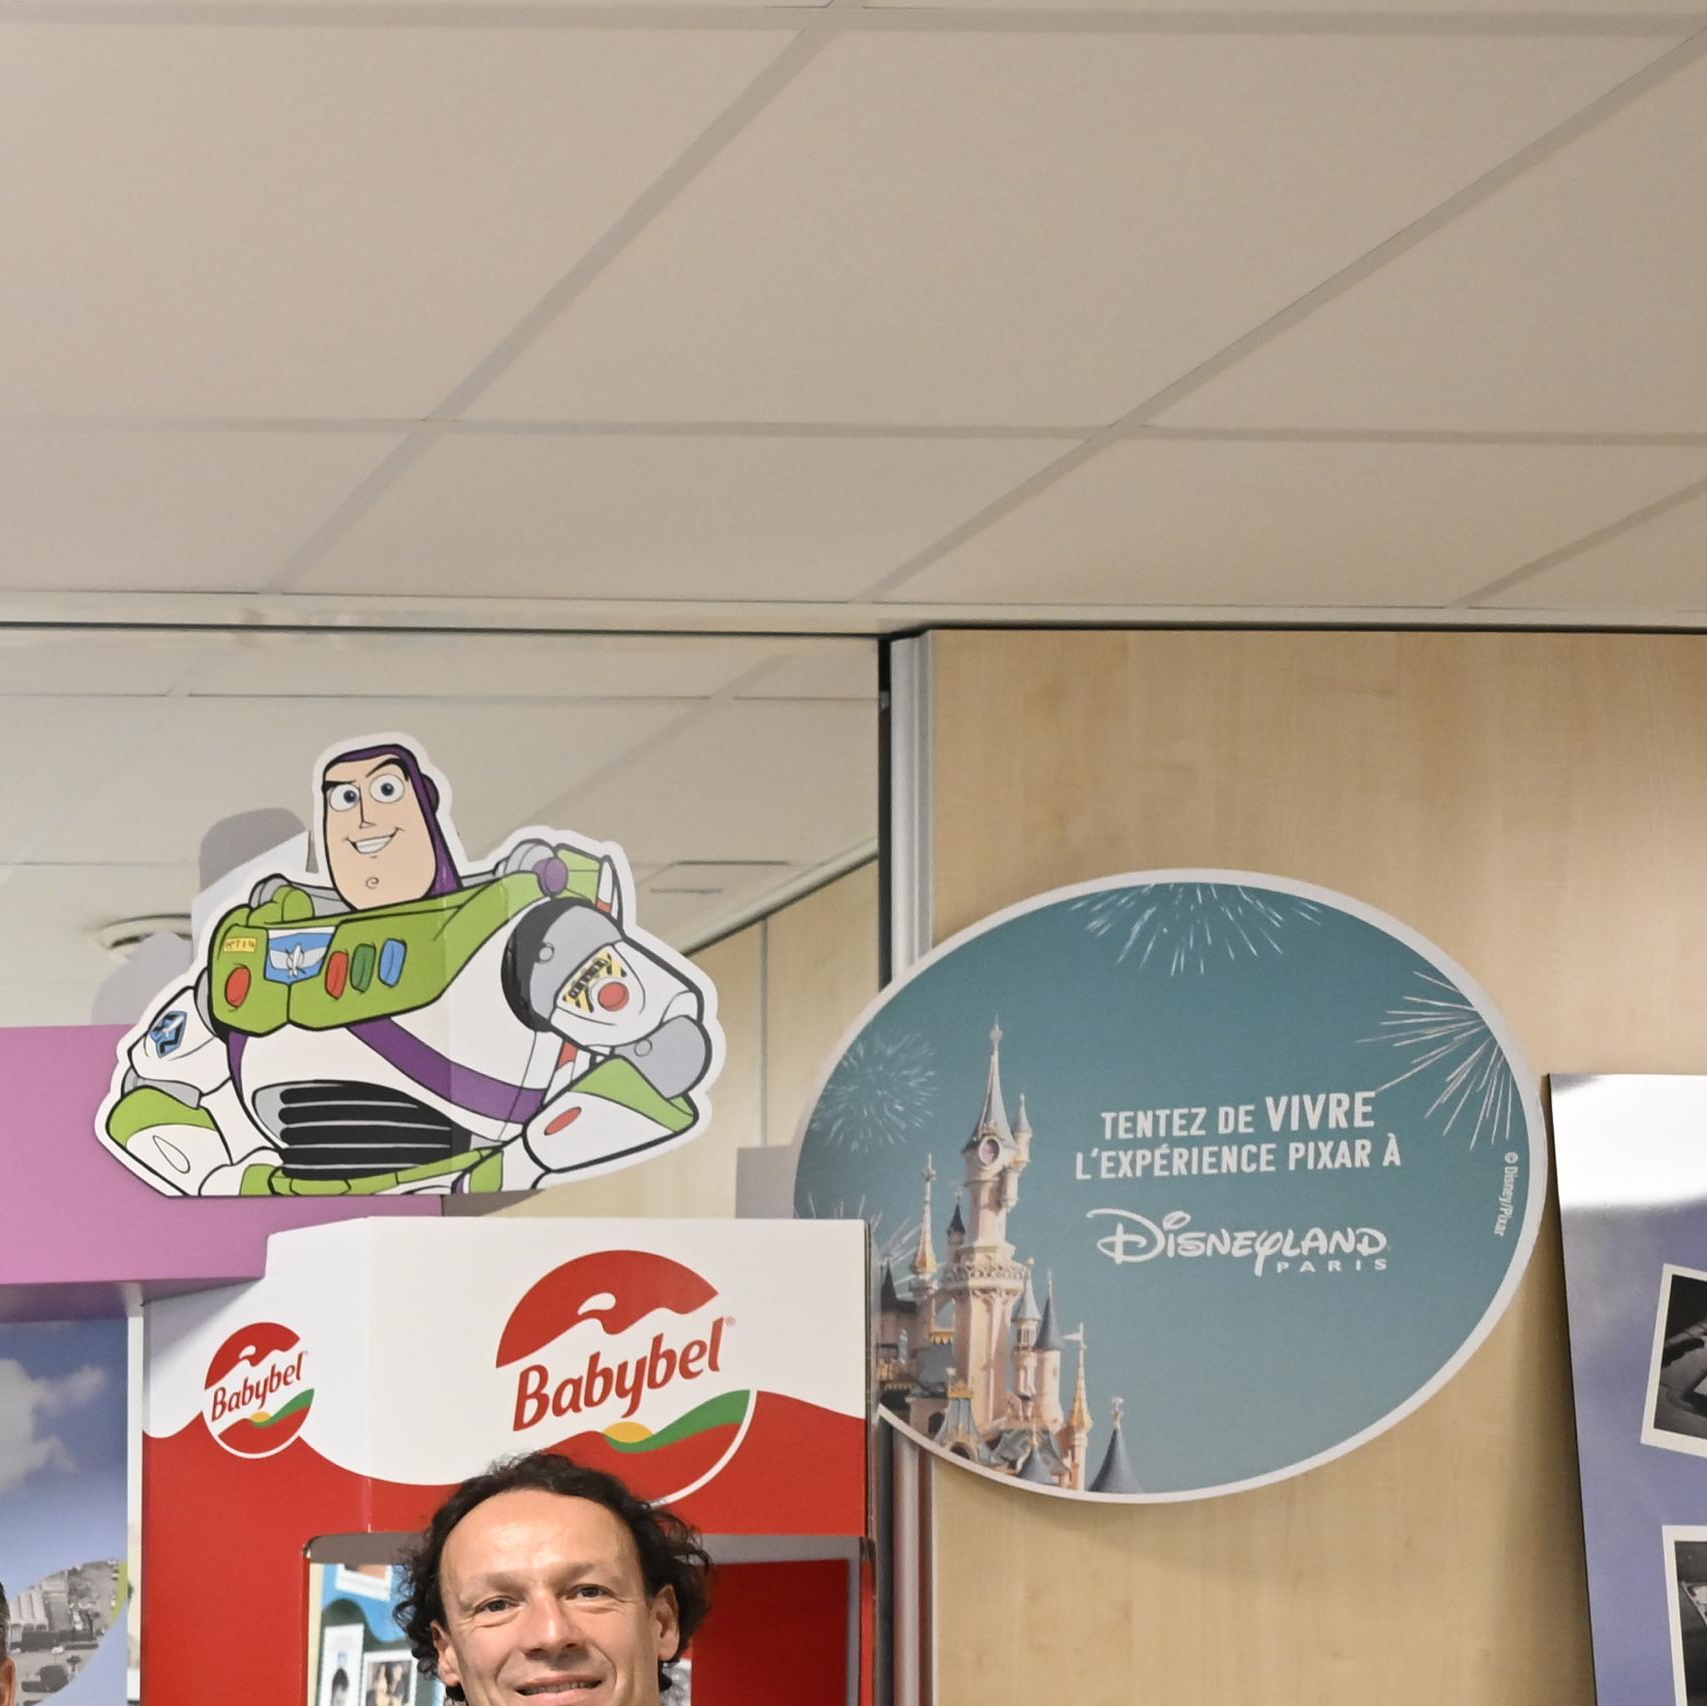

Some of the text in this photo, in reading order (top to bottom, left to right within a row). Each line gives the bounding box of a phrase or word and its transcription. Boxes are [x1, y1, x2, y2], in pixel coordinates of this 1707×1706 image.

[1101, 1091, 1376, 1140] TENTEZ DE VIVRE
[1076, 1133, 1401, 1180] L'EXPÉRIENCE PIXAR À
[1277, 1258, 1387, 1273] PARIS
[211, 1351, 303, 1422] Babybel
[513, 1316, 725, 1431] Babybel
